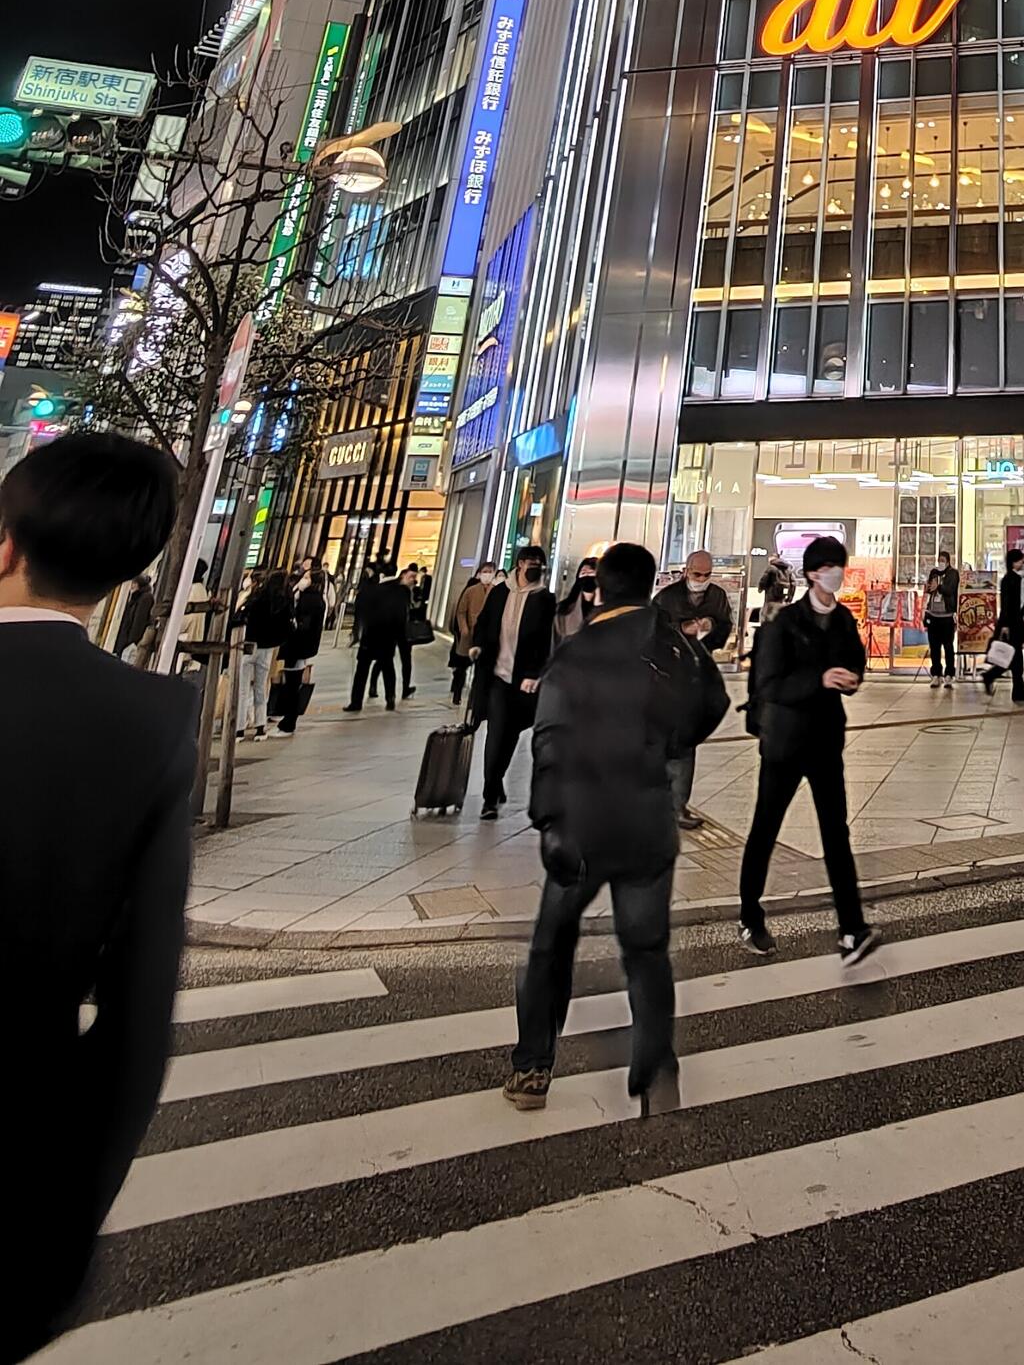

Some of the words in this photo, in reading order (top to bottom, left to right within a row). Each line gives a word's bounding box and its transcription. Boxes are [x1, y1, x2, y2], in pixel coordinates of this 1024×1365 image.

[481, 16, 514, 111] みずほ信託銀行
[23, 82, 89, 103] Shinjuku
[30, 64, 146, 96] 新宿駅東口
[463, 130, 492, 205] みずほ銀行
[328, 441, 367, 468] GUCCI
